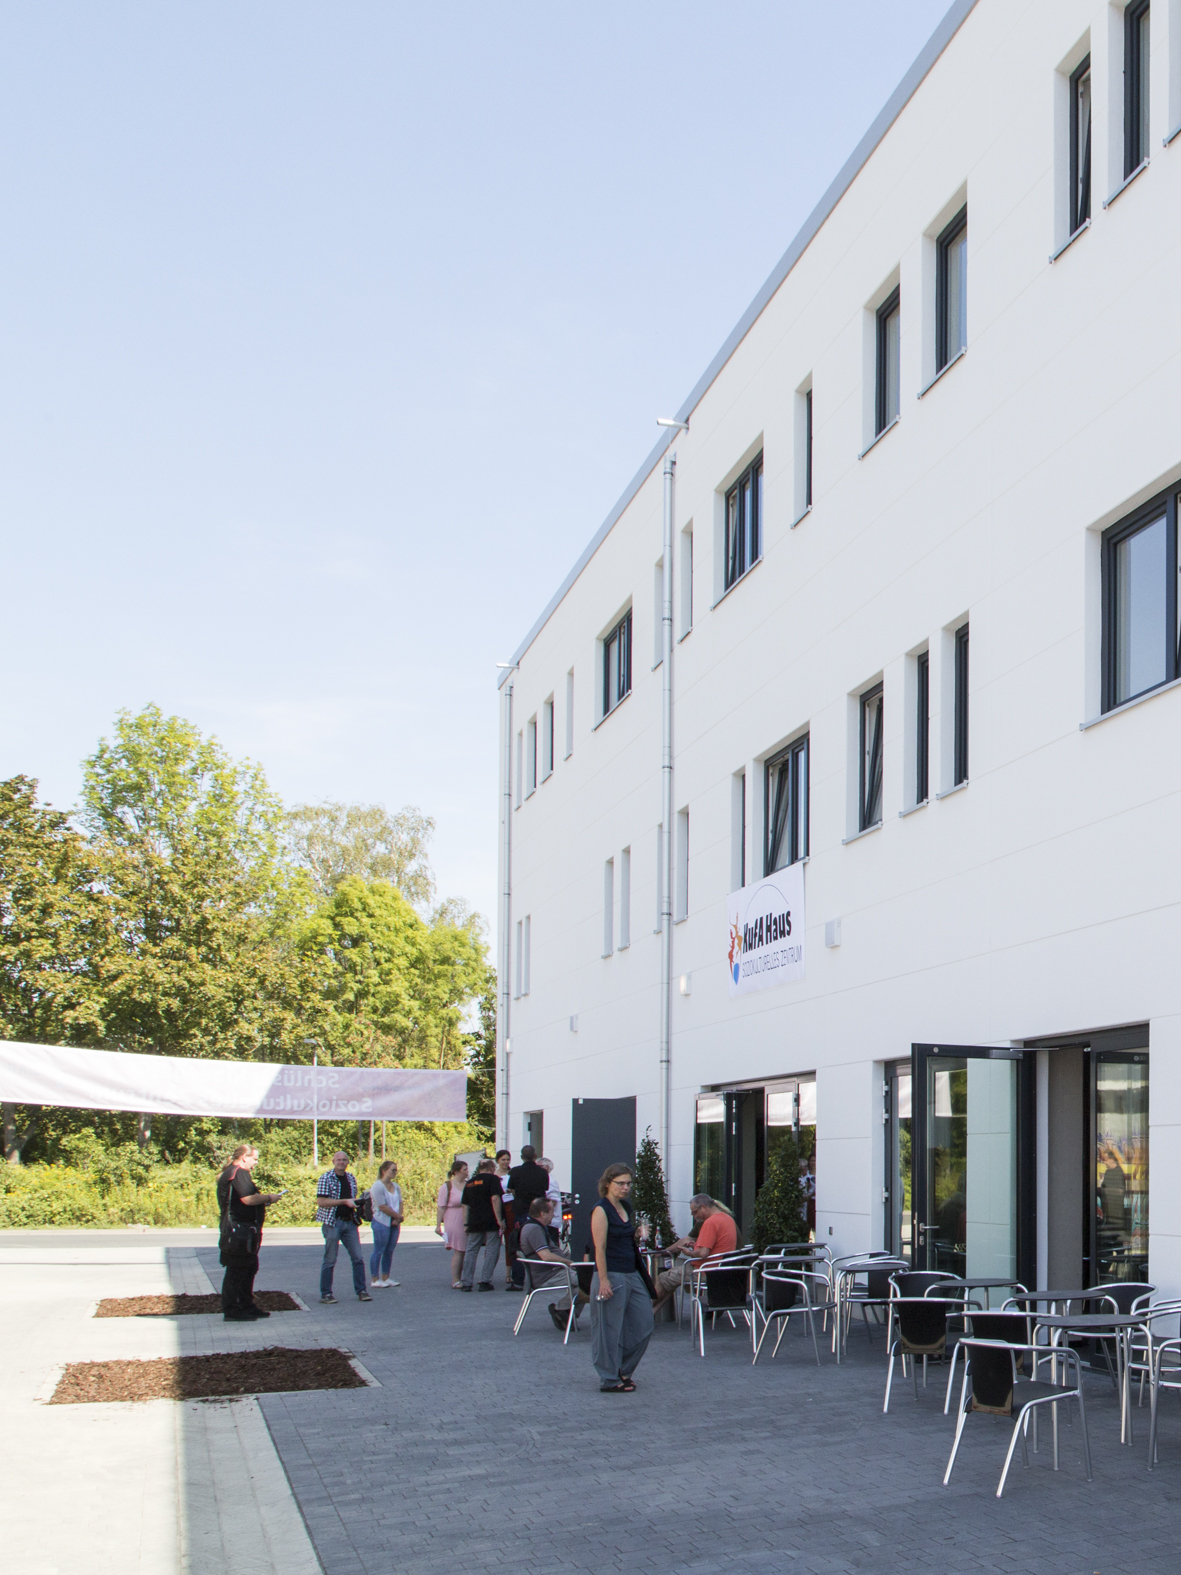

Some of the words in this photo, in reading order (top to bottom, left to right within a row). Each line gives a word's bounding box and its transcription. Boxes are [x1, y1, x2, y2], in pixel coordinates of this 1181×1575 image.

[743, 916, 763, 954] KufA
[765, 911, 792, 944] Haus
[780, 944, 803, 967] ZENTRUM
